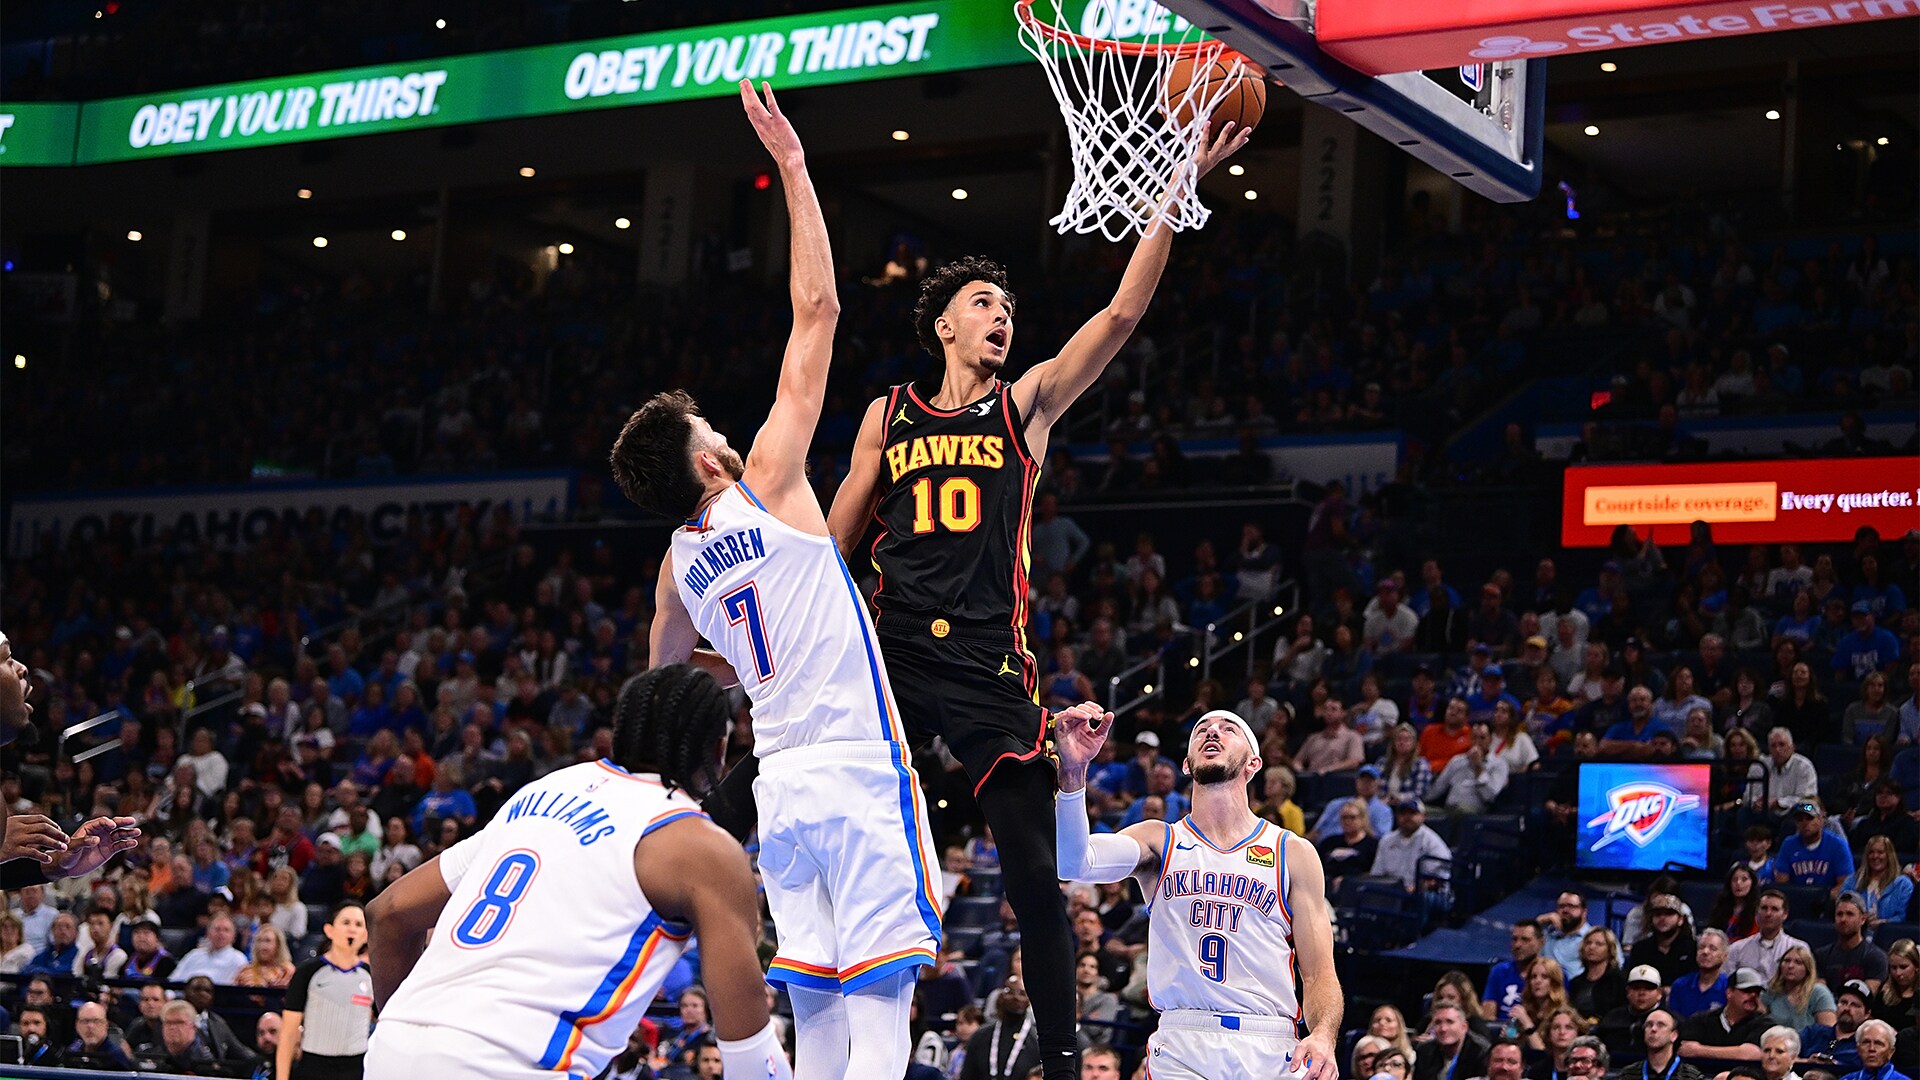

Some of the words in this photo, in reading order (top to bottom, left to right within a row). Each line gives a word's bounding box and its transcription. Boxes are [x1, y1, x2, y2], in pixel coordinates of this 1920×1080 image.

[1080, 0, 1190, 39] OBE
[1567, 15, 1750, 47] State
[564, 45, 674, 99] OBEY
[671, 32, 785, 87] YOUR
[129, 97, 224, 148] OBEY
[219, 86, 317, 138] YOUR
[886, 434, 1005, 484] HAWKS
[912, 477, 981, 534] 10
[1595, 494, 1681, 513] Courtside
[1684, 494, 1770, 513] coverage.
[1781, 491, 1835, 513] Every
[1837, 489, 1912, 513] quarter.
[685, 528, 766, 600] HOLMGREN
[719, 580, 775, 684] 7
[933, 623, 948, 633] ATL
[506, 791, 615, 846] WILLIAMS
[1608, 794, 1663, 833] OKC
[450, 848, 541, 950] 8
[1162, 870, 1278, 917] OKLAHOMA
[1189, 899, 1244, 932] CITY
[1199, 932, 1228, 984] 9
